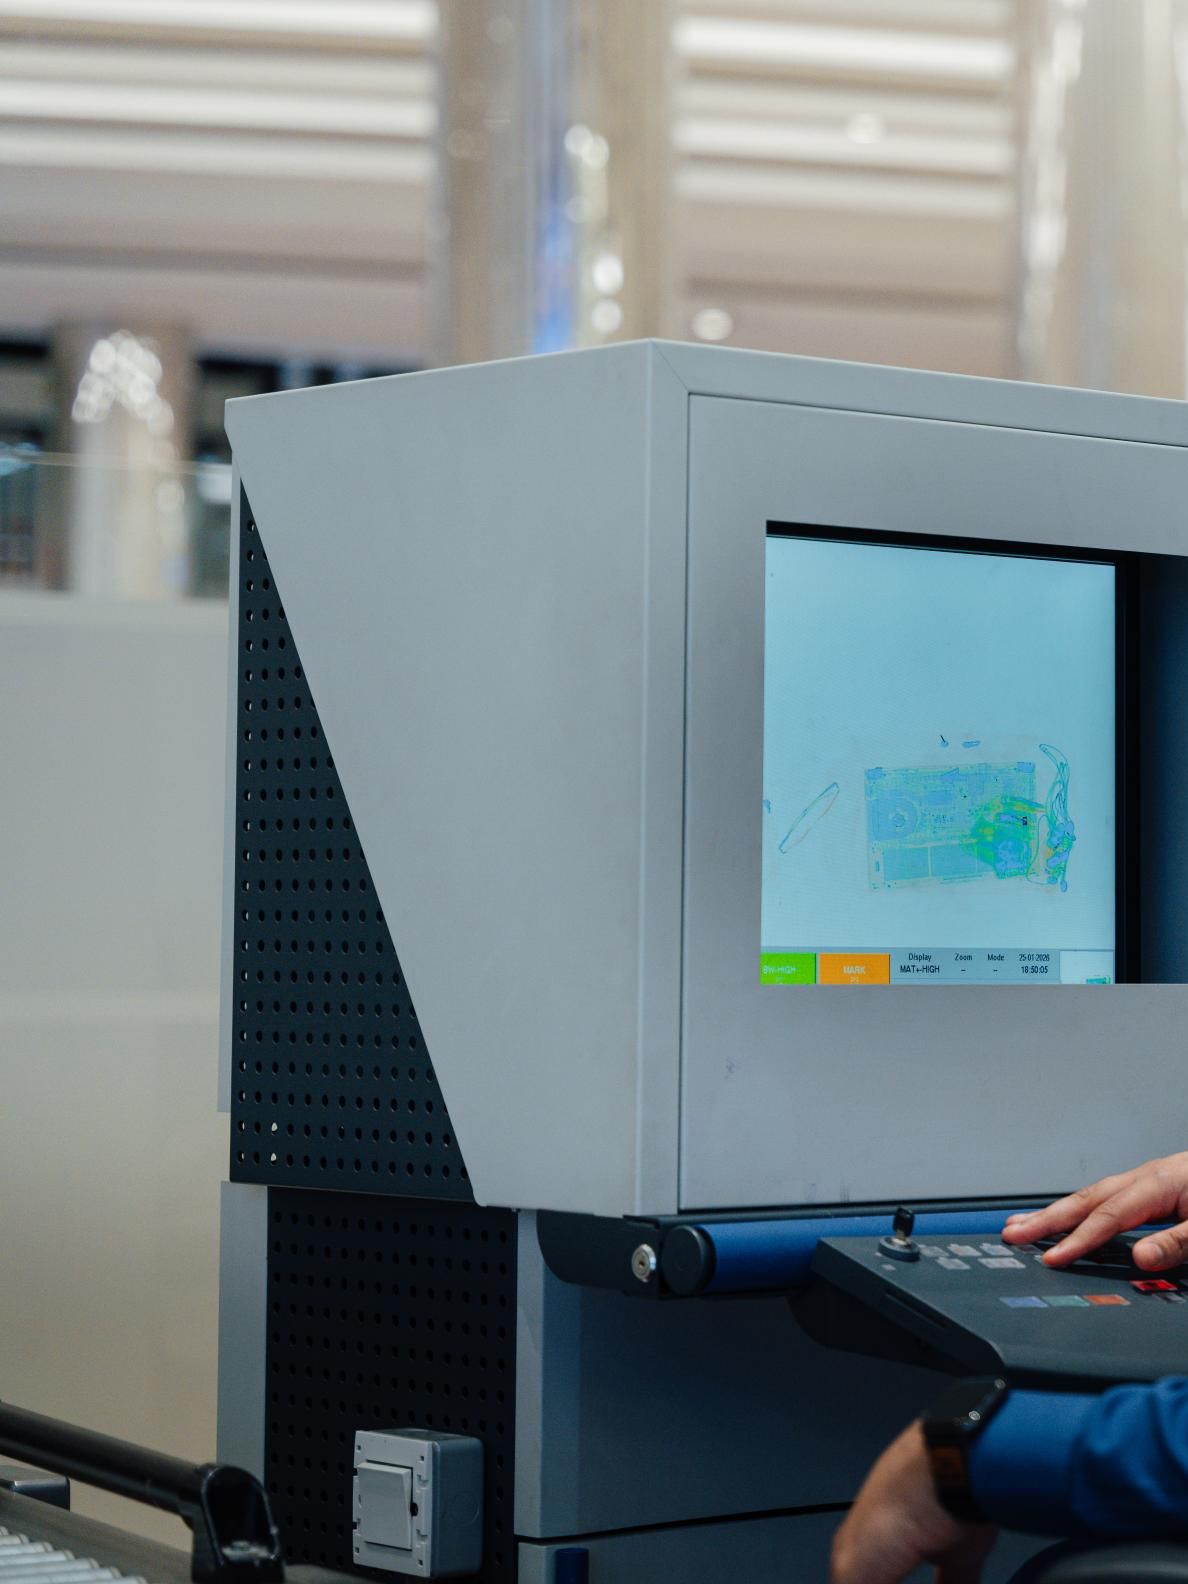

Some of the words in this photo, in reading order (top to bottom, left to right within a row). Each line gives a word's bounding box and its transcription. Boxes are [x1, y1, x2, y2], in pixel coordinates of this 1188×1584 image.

[908, 953, 932, 963] Display
[954, 953, 973, 961] Zoom
[987, 953, 1005, 961] Mode
[1021, 965, 1049, 974] 18:50:05
